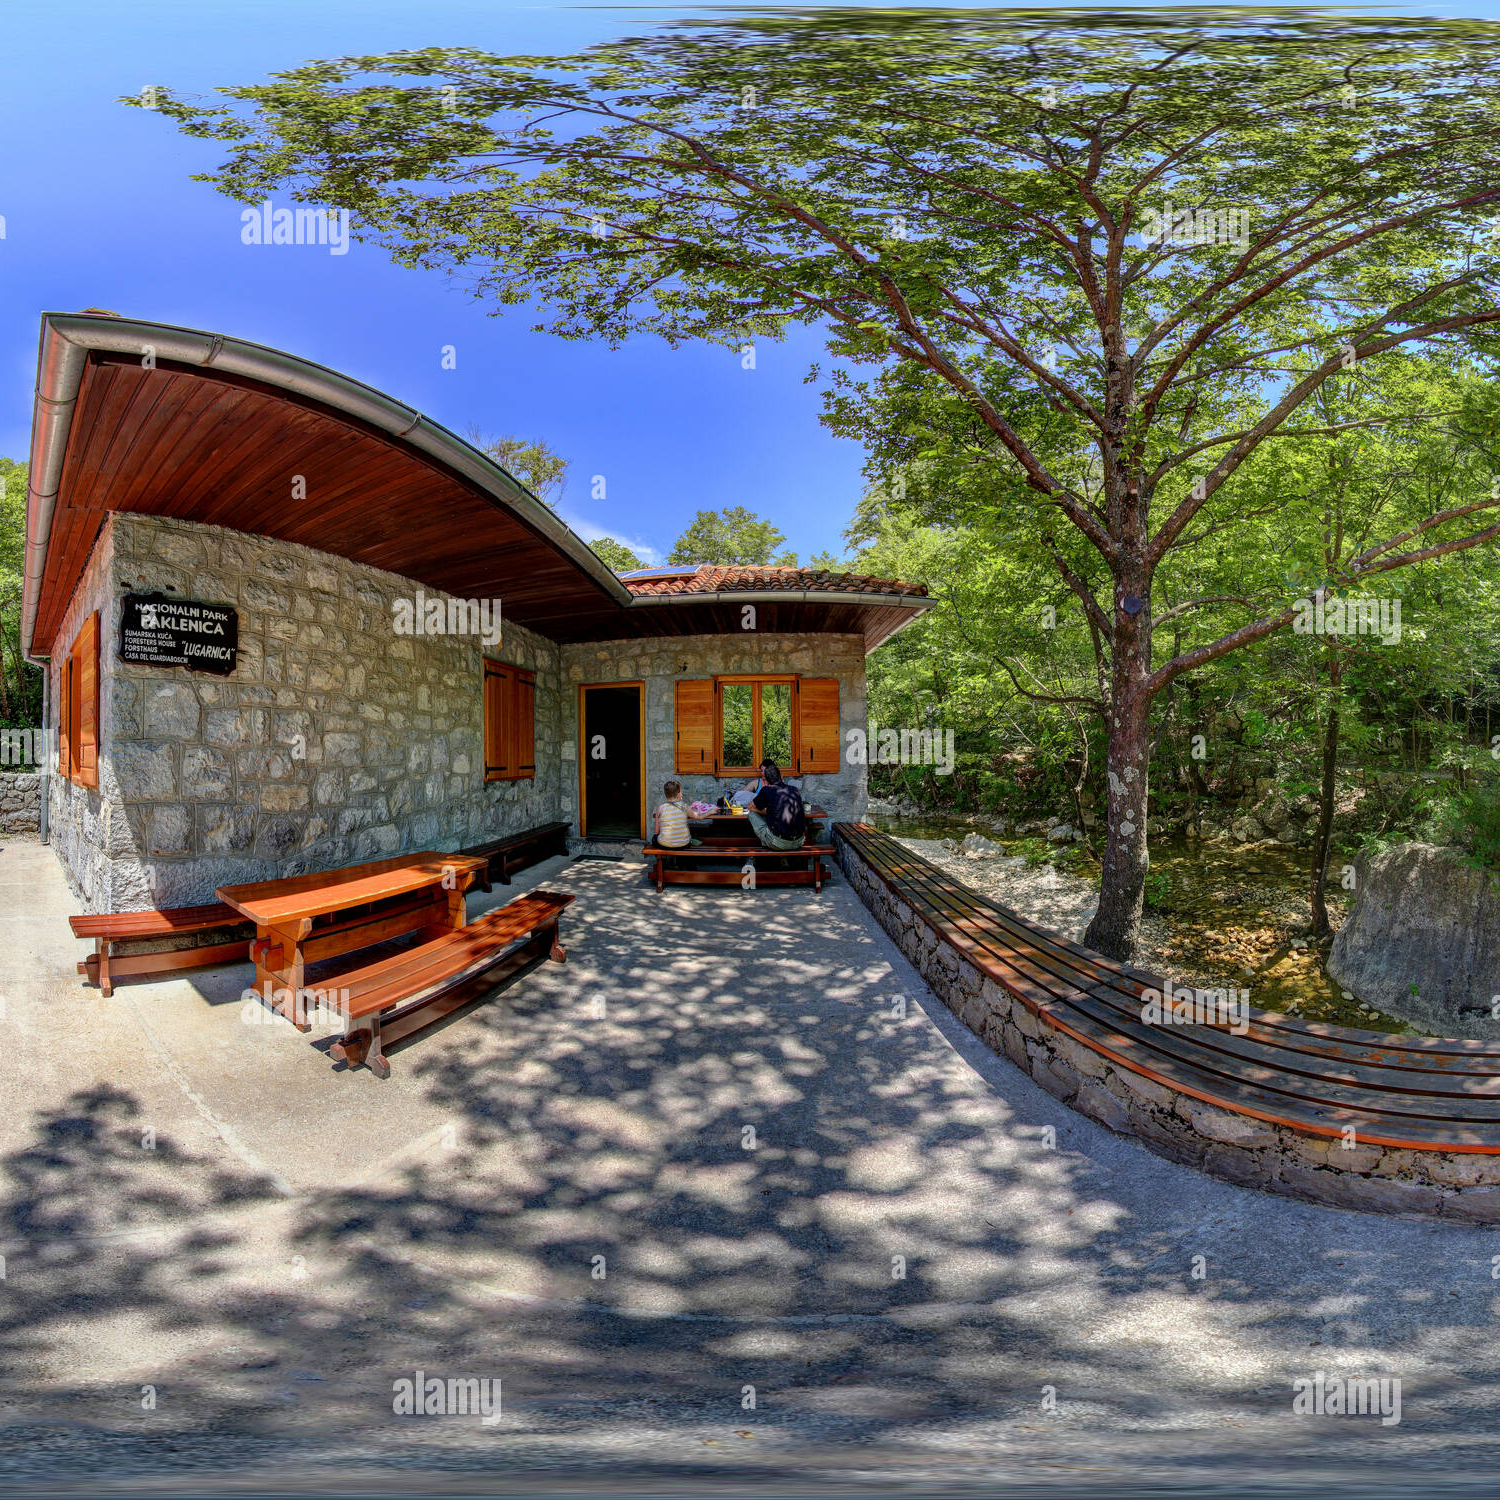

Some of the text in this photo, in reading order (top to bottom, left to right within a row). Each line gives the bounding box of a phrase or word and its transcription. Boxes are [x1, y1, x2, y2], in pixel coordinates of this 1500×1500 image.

[202, 609, 228, 621] PARK
[141, 615, 225, 636] PAKLENICA
[125, 637, 157, 646] FORESTERS
[125, 645, 158, 653] FORSTHAUS
